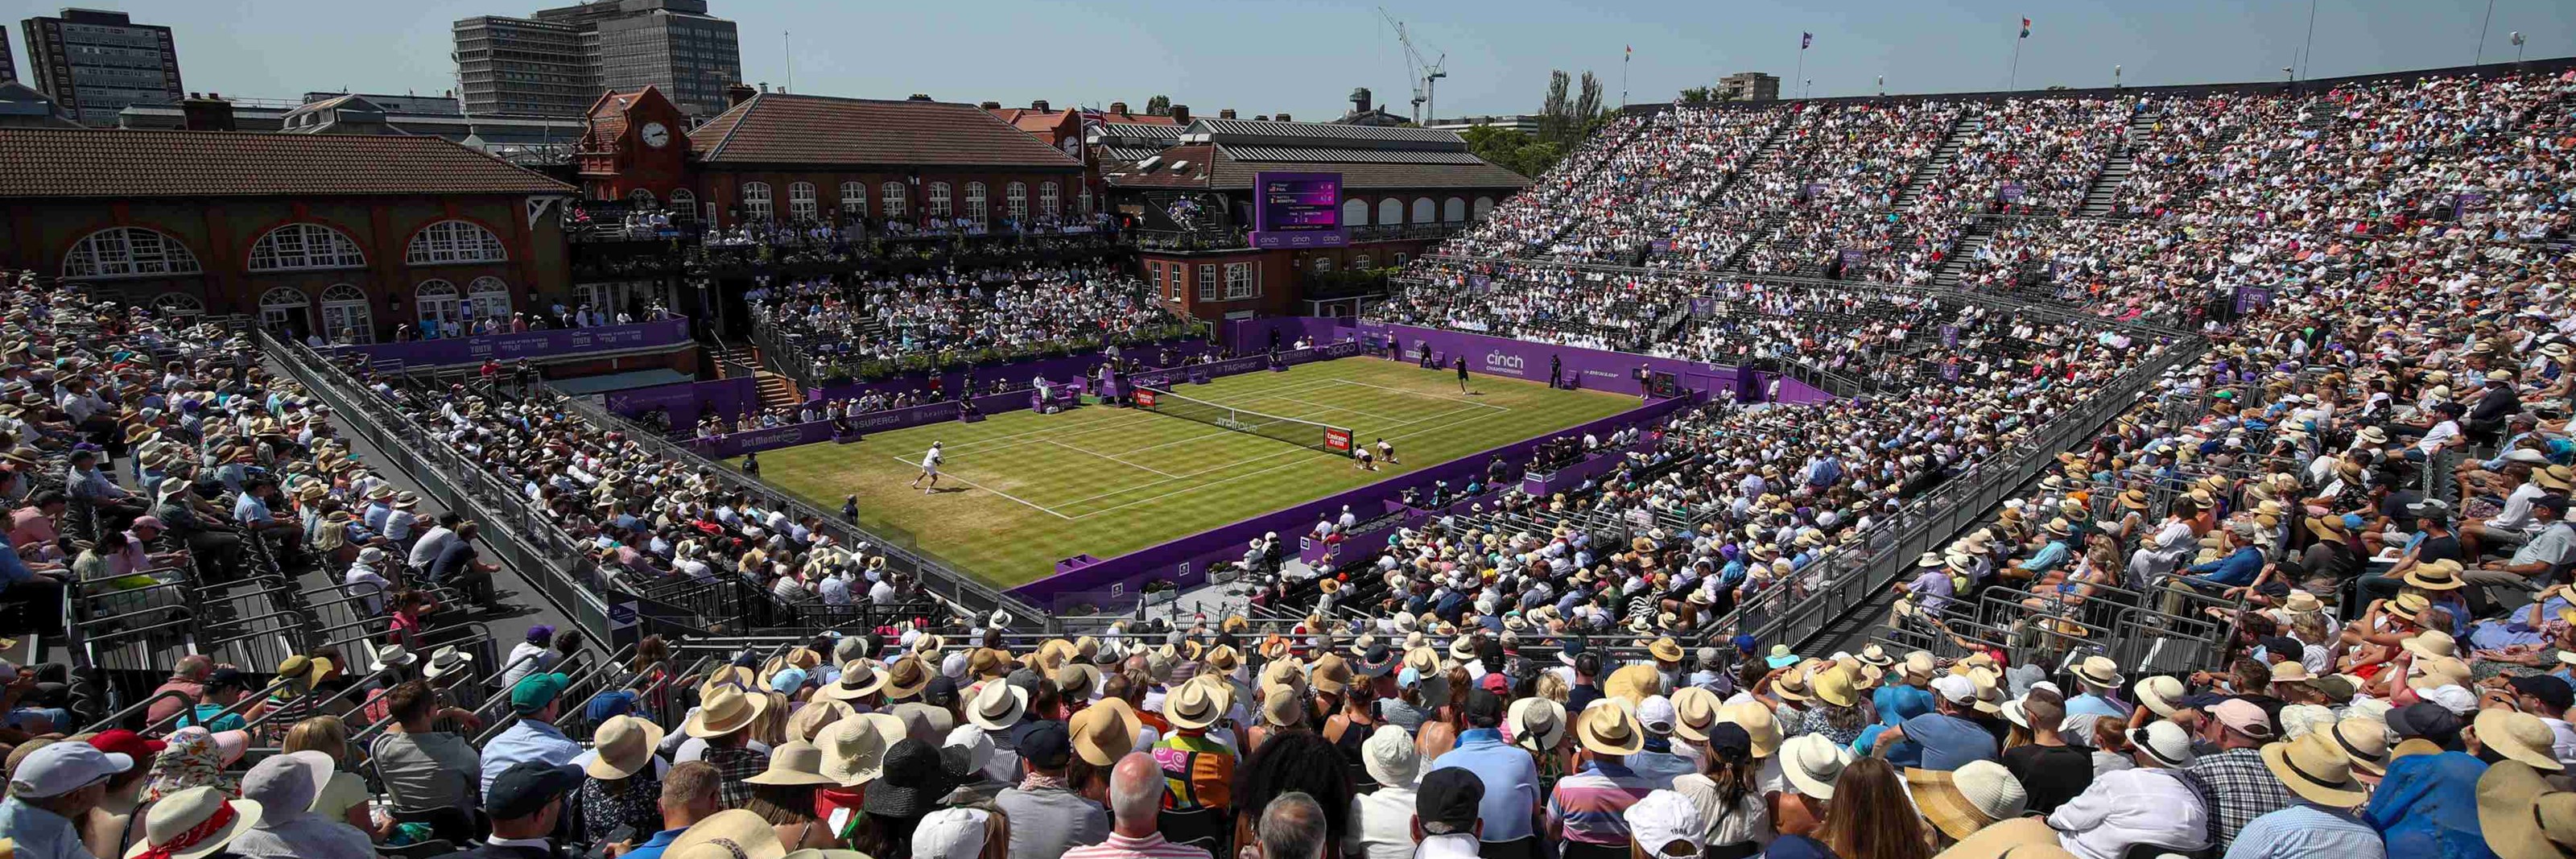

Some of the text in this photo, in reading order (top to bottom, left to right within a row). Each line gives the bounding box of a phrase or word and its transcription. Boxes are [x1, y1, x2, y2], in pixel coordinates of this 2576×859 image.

[1328, 343, 1356, 357] oppo
[1487, 349, 1524, 369] cinch
[858, 415, 900, 428] SUPERGA
